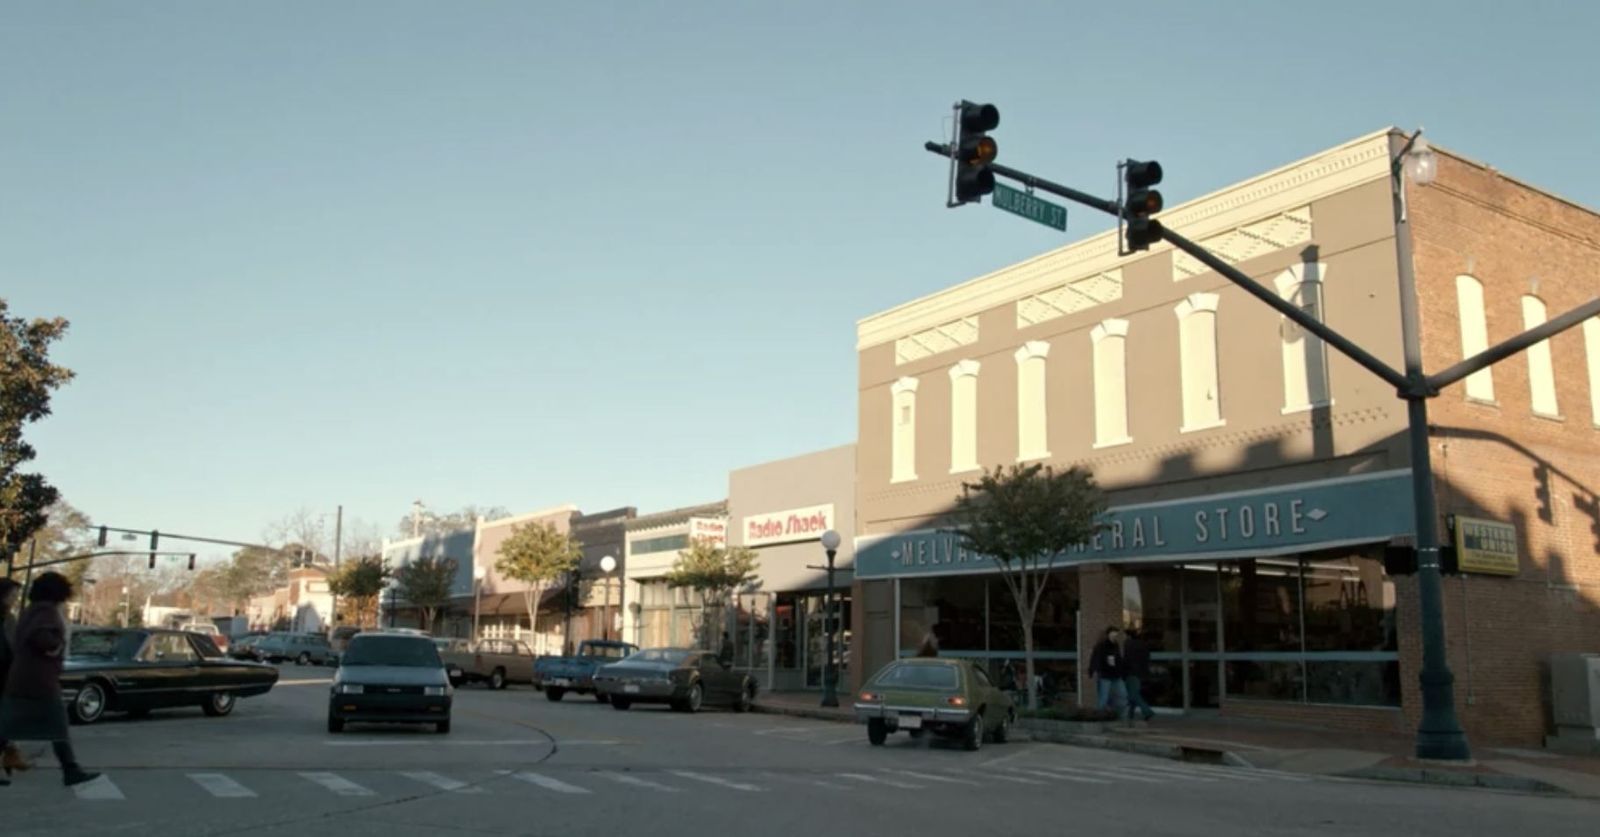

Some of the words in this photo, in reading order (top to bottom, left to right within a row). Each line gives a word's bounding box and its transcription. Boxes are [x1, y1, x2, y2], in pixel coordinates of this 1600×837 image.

[995, 184, 1045, 220] MULBERRY
[749, 518, 783, 539] Radio
[785, 510, 827, 534] Shack
[1195, 499, 1306, 542] STORE
[1463, 524, 1514, 540] WESTERN
[1480, 538, 1515, 553] UNION
